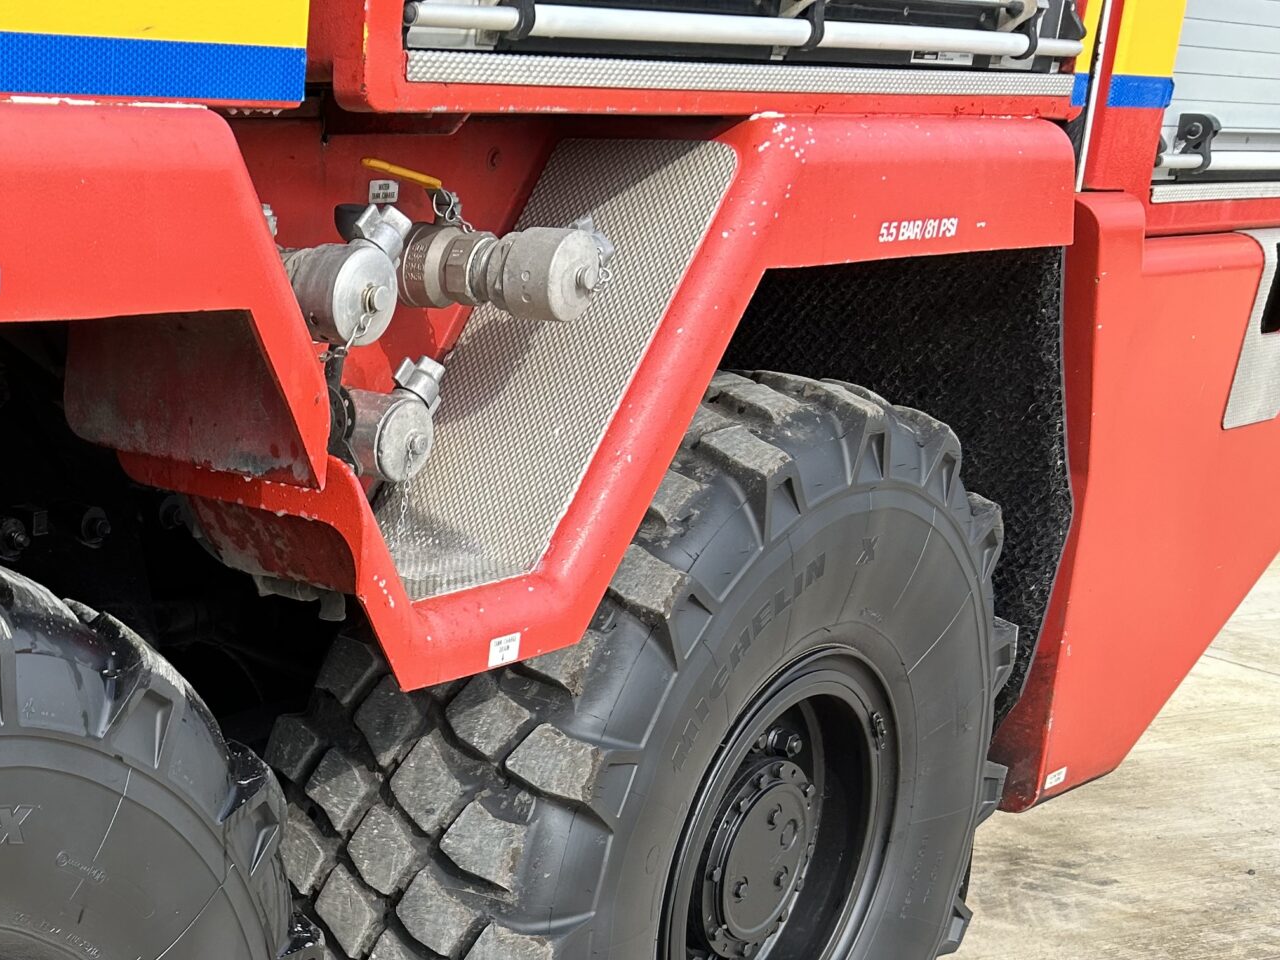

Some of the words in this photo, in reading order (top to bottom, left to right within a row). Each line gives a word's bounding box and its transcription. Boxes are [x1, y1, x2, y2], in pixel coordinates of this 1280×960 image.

[878, 221, 899, 243] 5.5
[898, 218, 940, 241] BAR/81
[939, 217, 959, 238] PSI
[671, 552, 827, 774] MICHELIN
